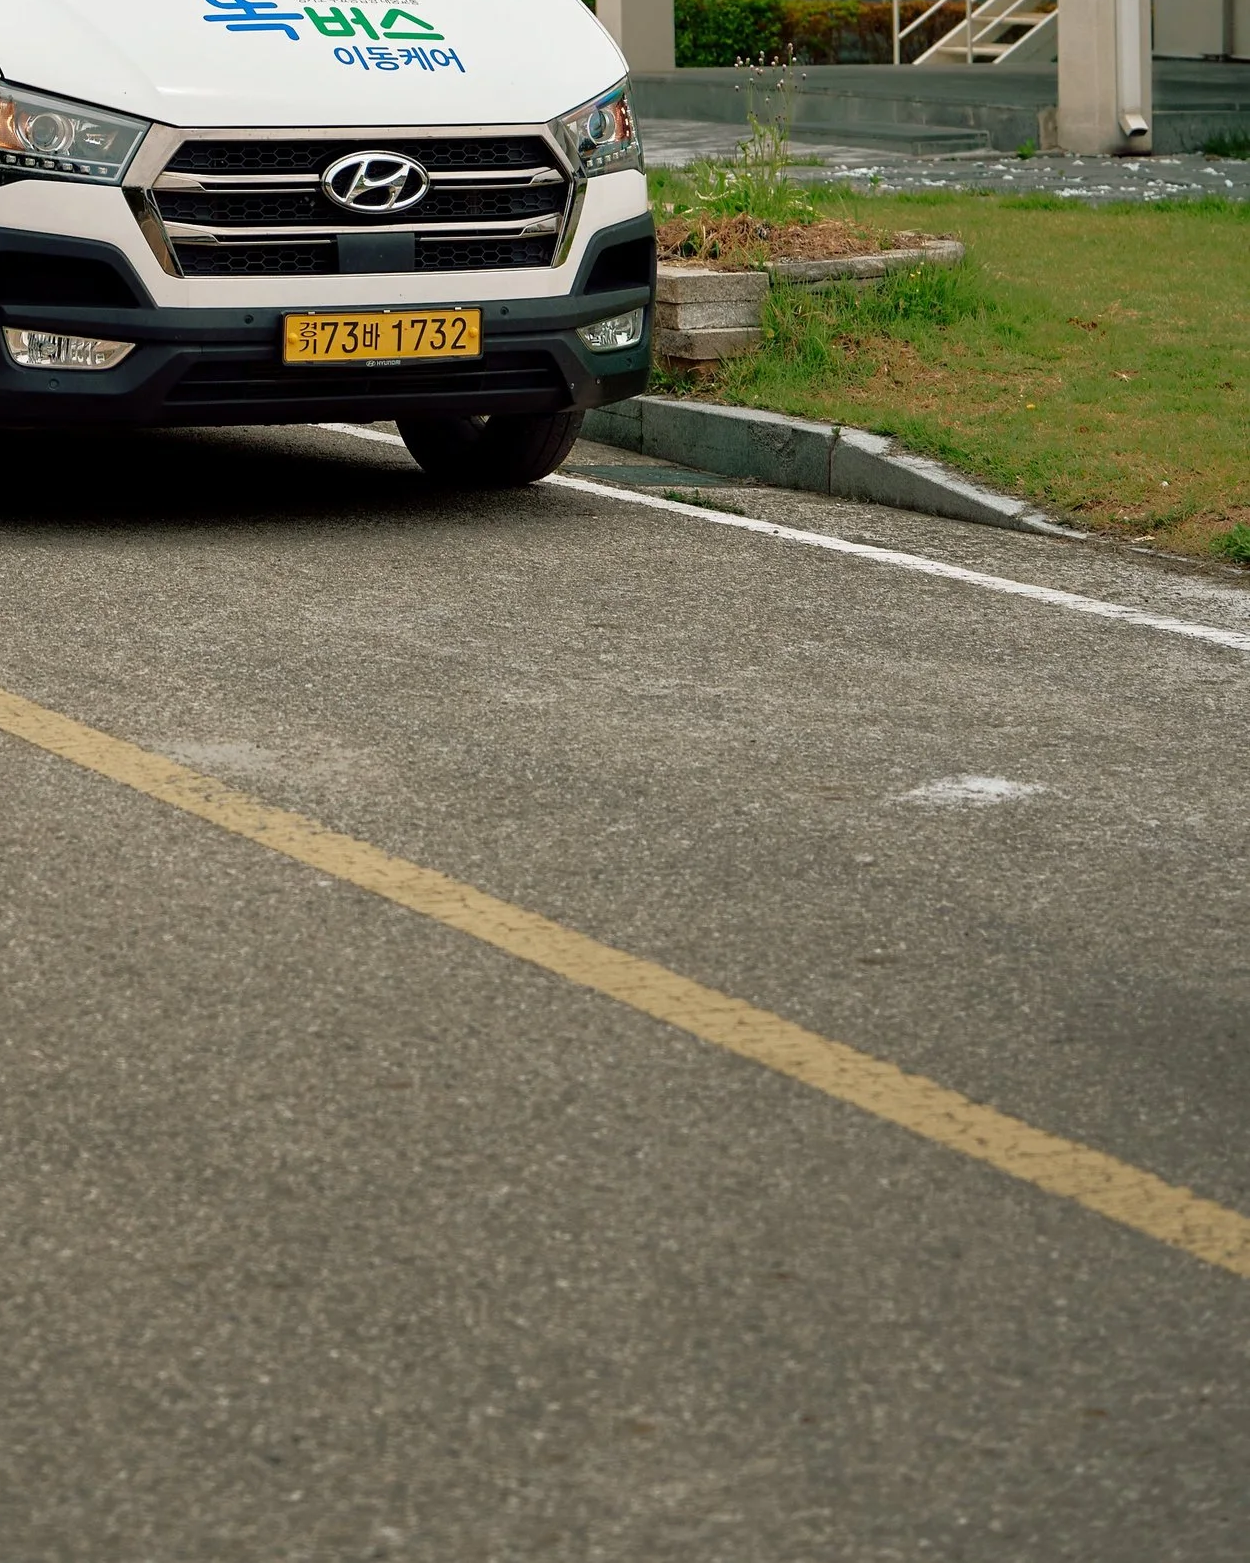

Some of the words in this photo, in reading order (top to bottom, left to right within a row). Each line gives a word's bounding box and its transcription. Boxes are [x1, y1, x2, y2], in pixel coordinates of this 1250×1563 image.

[333, 45, 466, 73] 이동케어
[299, 321, 318, 355] 경기
[320, 321, 381, 354] 73바
[391, 317, 467, 352] 1732
